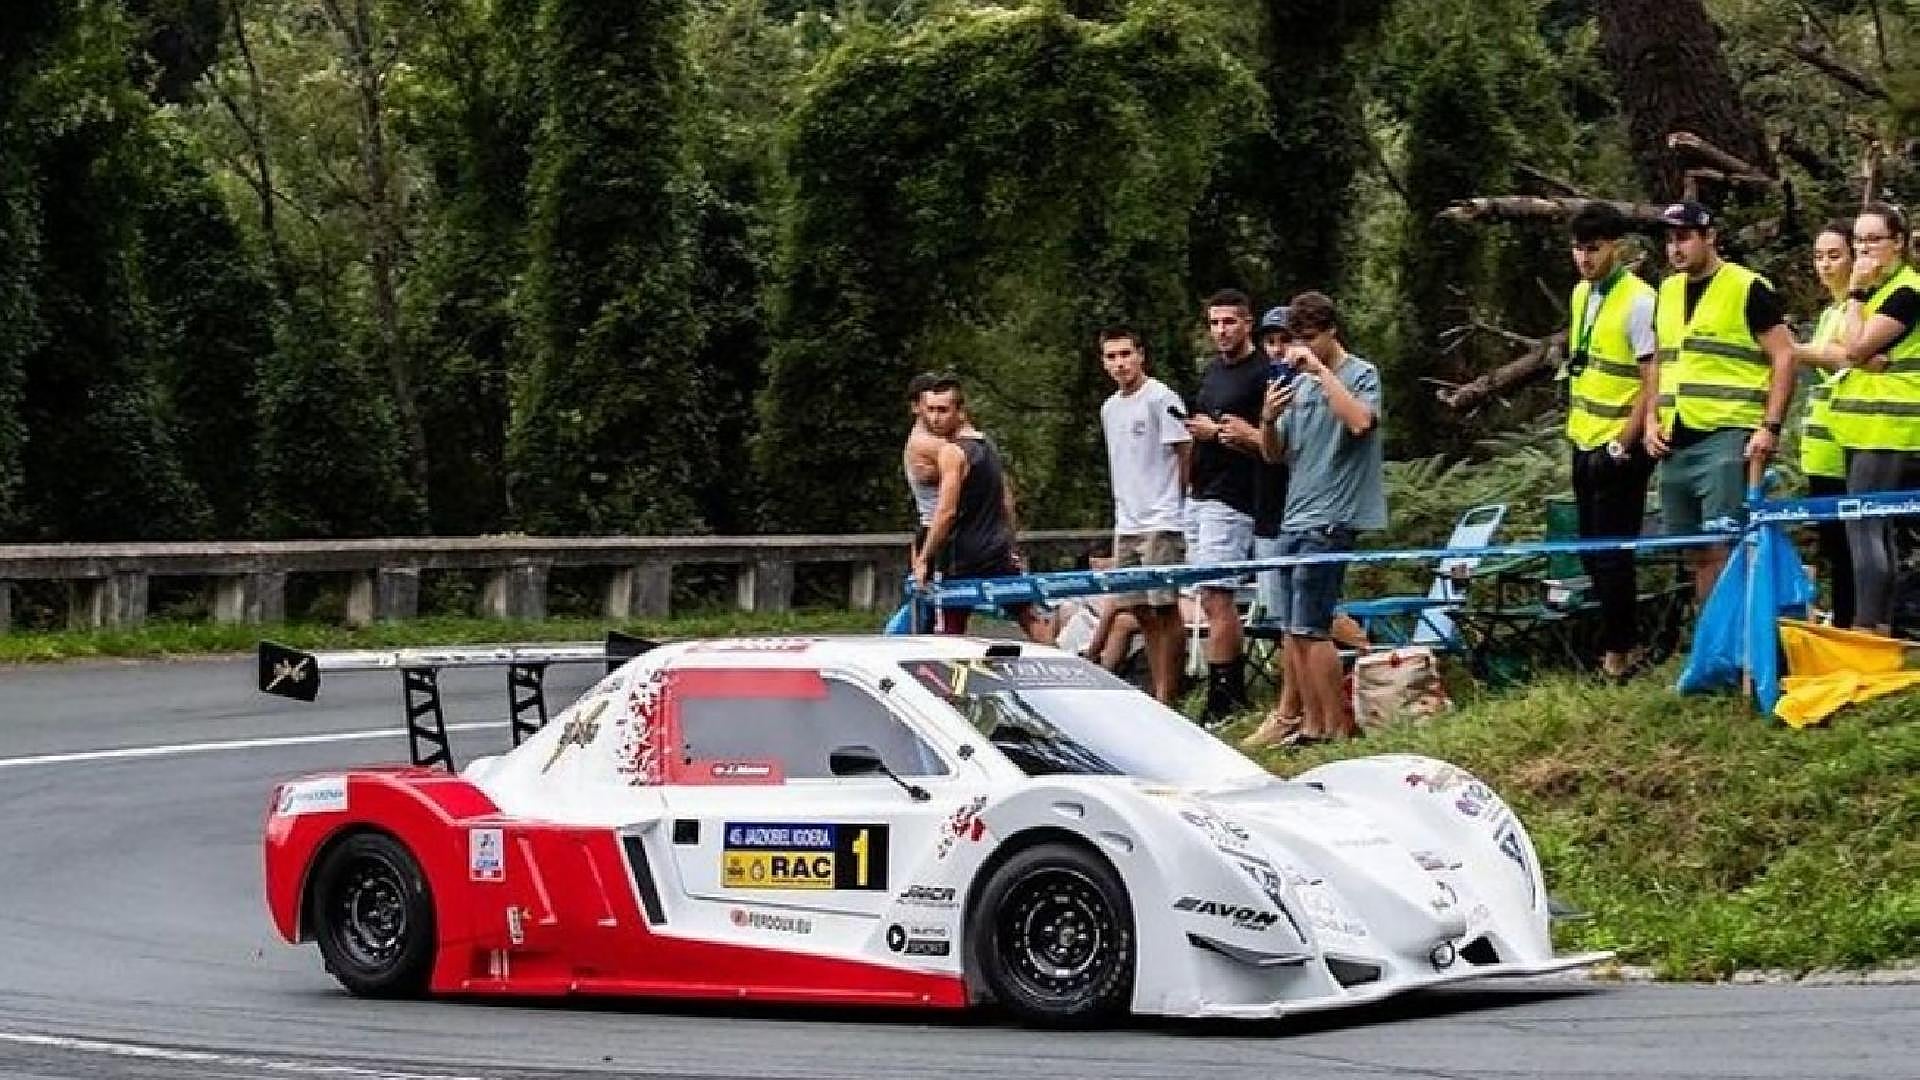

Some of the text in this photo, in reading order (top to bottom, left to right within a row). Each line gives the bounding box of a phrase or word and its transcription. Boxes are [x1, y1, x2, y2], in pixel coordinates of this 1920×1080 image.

[771, 855, 831, 879] RAC
[851, 828, 870, 887] 1
[1196, 900, 1278, 926] AVON
